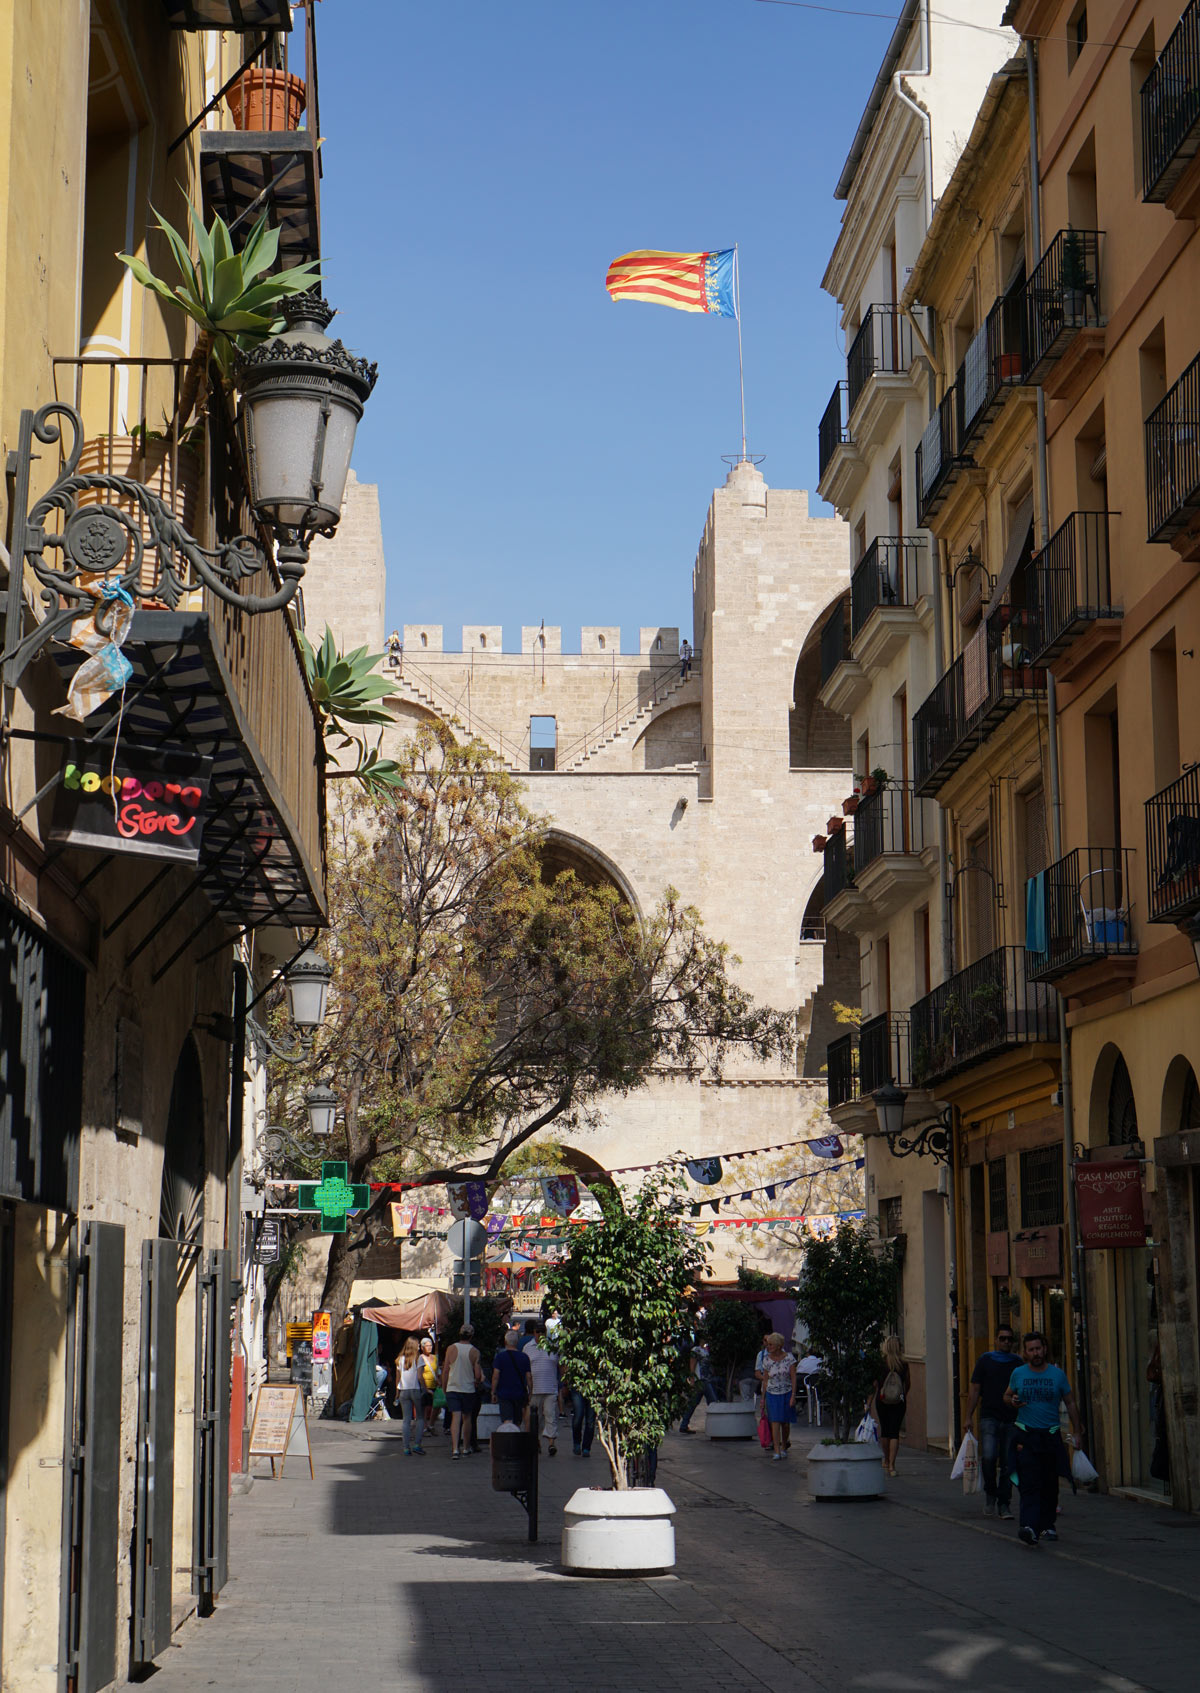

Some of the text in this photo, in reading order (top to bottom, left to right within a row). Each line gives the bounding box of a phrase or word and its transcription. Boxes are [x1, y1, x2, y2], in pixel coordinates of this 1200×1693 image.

[117, 803, 196, 838] Store
[1077, 1170, 1138, 1182] CASA MONET
[1102, 1206, 1121, 1214] ARTE
[1098, 1222, 1130, 1231] REGALOS
[1086, 1230, 1143, 1240] COMPLEMENTOS
[1023, 1378, 1054, 1386] DOMYOS
